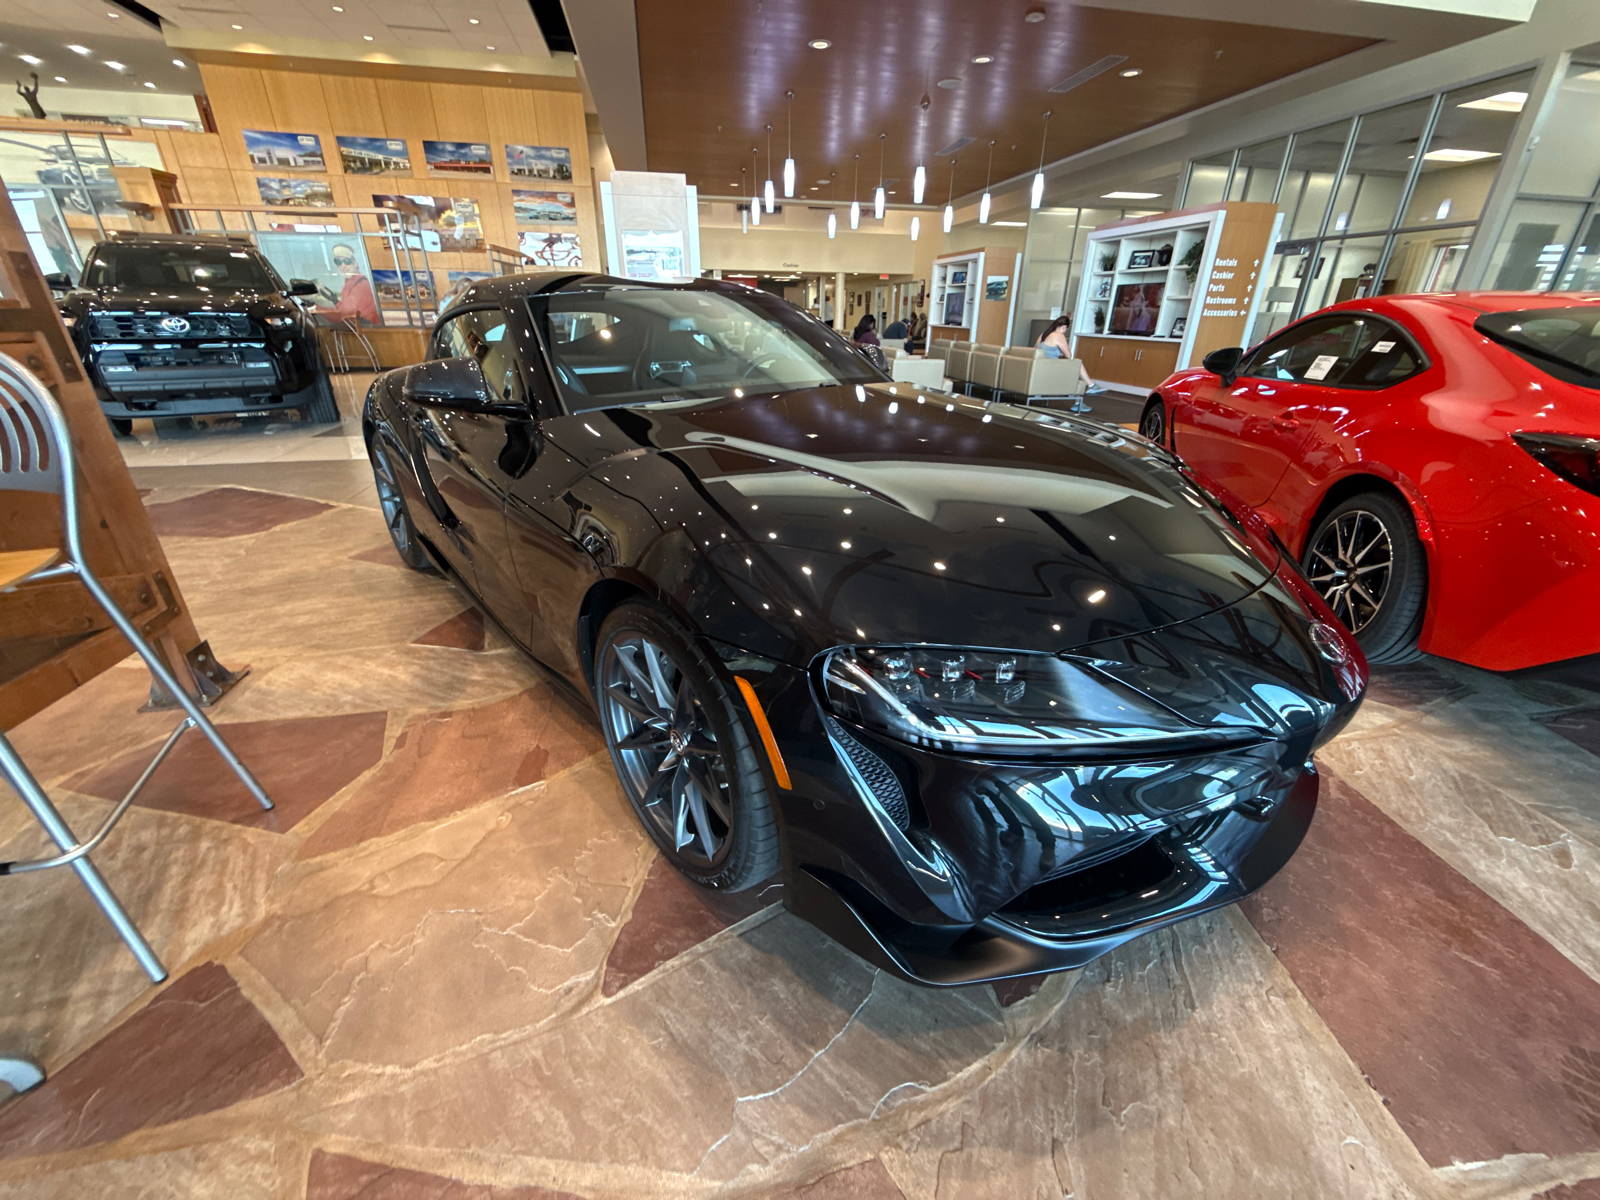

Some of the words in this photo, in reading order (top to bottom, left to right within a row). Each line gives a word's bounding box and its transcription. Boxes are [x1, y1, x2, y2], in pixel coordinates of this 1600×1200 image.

[1214, 258, 1238, 267] Rentals
[1211, 270, 1235, 279] Cashier
[1208, 283, 1225, 292] Parts
[1205, 296, 1237, 305] Restrooms
[1202, 308, 1238, 317] Accessories
